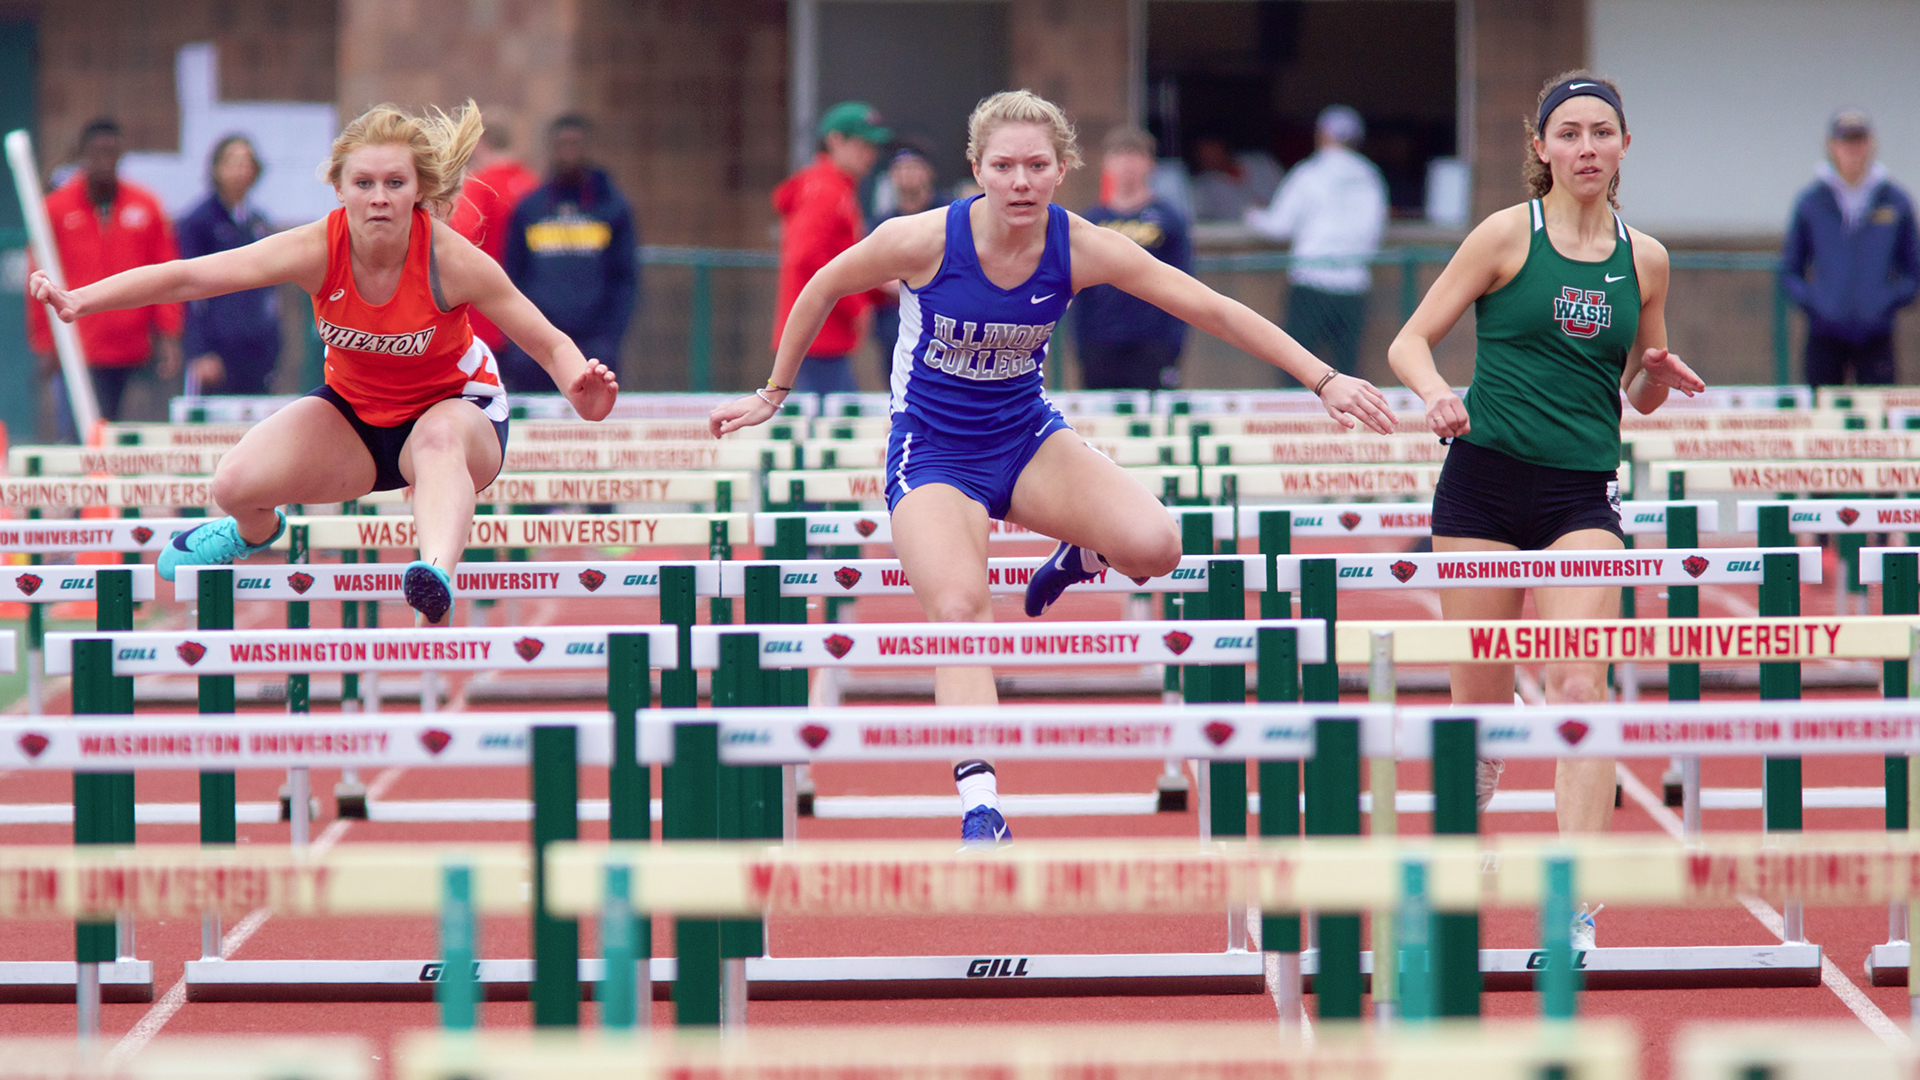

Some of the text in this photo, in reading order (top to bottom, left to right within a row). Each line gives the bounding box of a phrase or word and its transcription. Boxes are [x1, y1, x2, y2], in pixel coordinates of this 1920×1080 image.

[1554, 297, 1611, 328] WASH
[319, 317, 437, 357] WHEATON
[933, 313, 1057, 350] ILLINOIS
[923, 339, 1037, 381] COLLEGE
[610, 449, 719, 468] UNIVERSITY
[1272, 443, 1391, 463] WASHINGTON
[1673, 438, 1912, 459] WASHINGTON UNIVERSITY
[79, 453, 201, 474] WASHINGTON
[1282, 471, 1417, 492] WASHINGTON
[1730, 467, 1864, 490] WASHINGTON
[549, 479, 671, 502] UNIVERSITY
[1294, 517, 1324, 527] GILL
[1634, 513, 1664, 523] GILL
[1791, 511, 1822, 522] GILL
[24, 529, 113, 546] UNIVERSITY
[523, 520, 658, 544] UNIVERSITY
[809, 523, 839, 534] GILL
[783, 573, 818, 585] GILL
[1171, 568, 1206, 580] GILL
[1339, 559, 1761, 579] GILL WASHINGTON UNIVERSITY GILL
[60, 578, 95, 590] GILL
[237, 578, 272, 589] GILL
[457, 573, 560, 591] UNIVERSITY
[623, 574, 658, 586] GILL
[117, 641, 604, 662] GILL WASHINGTON UNIVERSITY GILL
[764, 635, 1254, 655] GILL WASHINGTON UNIVERSITY GILL
[1470, 624, 1841, 659] WASHINGTON UNIVERSITY
[79, 732, 387, 757] WASHINGTON UNIVERSITY
[966, 958, 1029, 979] GILL
